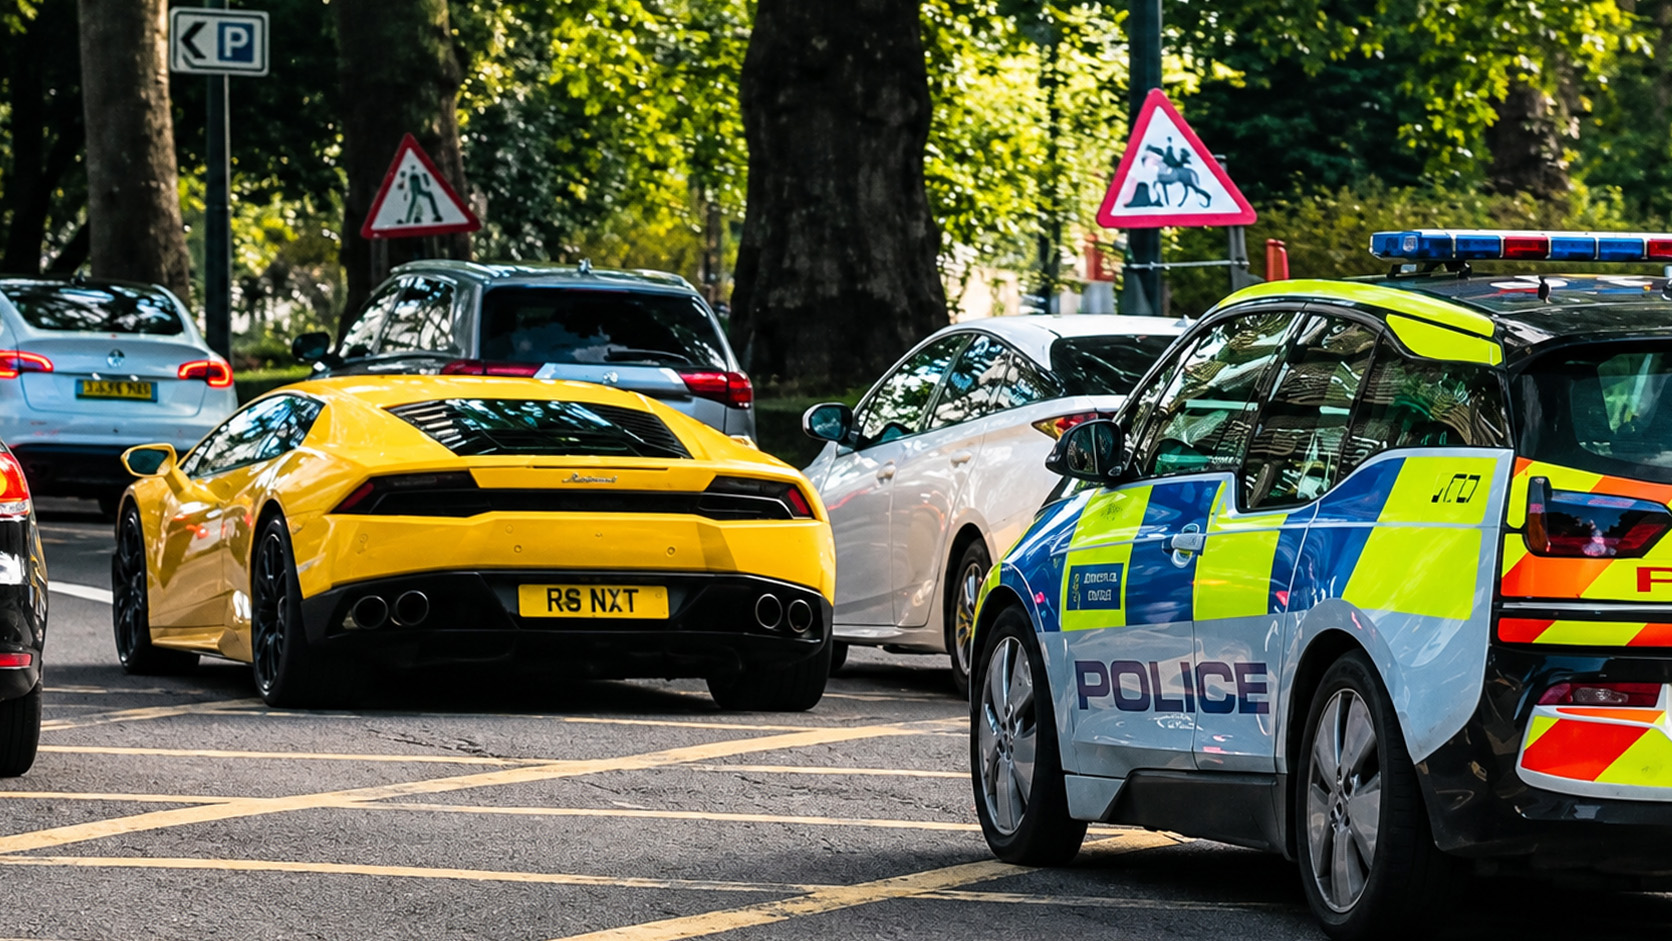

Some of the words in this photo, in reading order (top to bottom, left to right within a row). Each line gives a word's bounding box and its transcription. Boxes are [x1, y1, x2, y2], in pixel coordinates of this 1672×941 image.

[224, 26, 249, 57] P
[590, 588, 639, 613] NXT
[1074, 660, 1270, 714] POLICE
